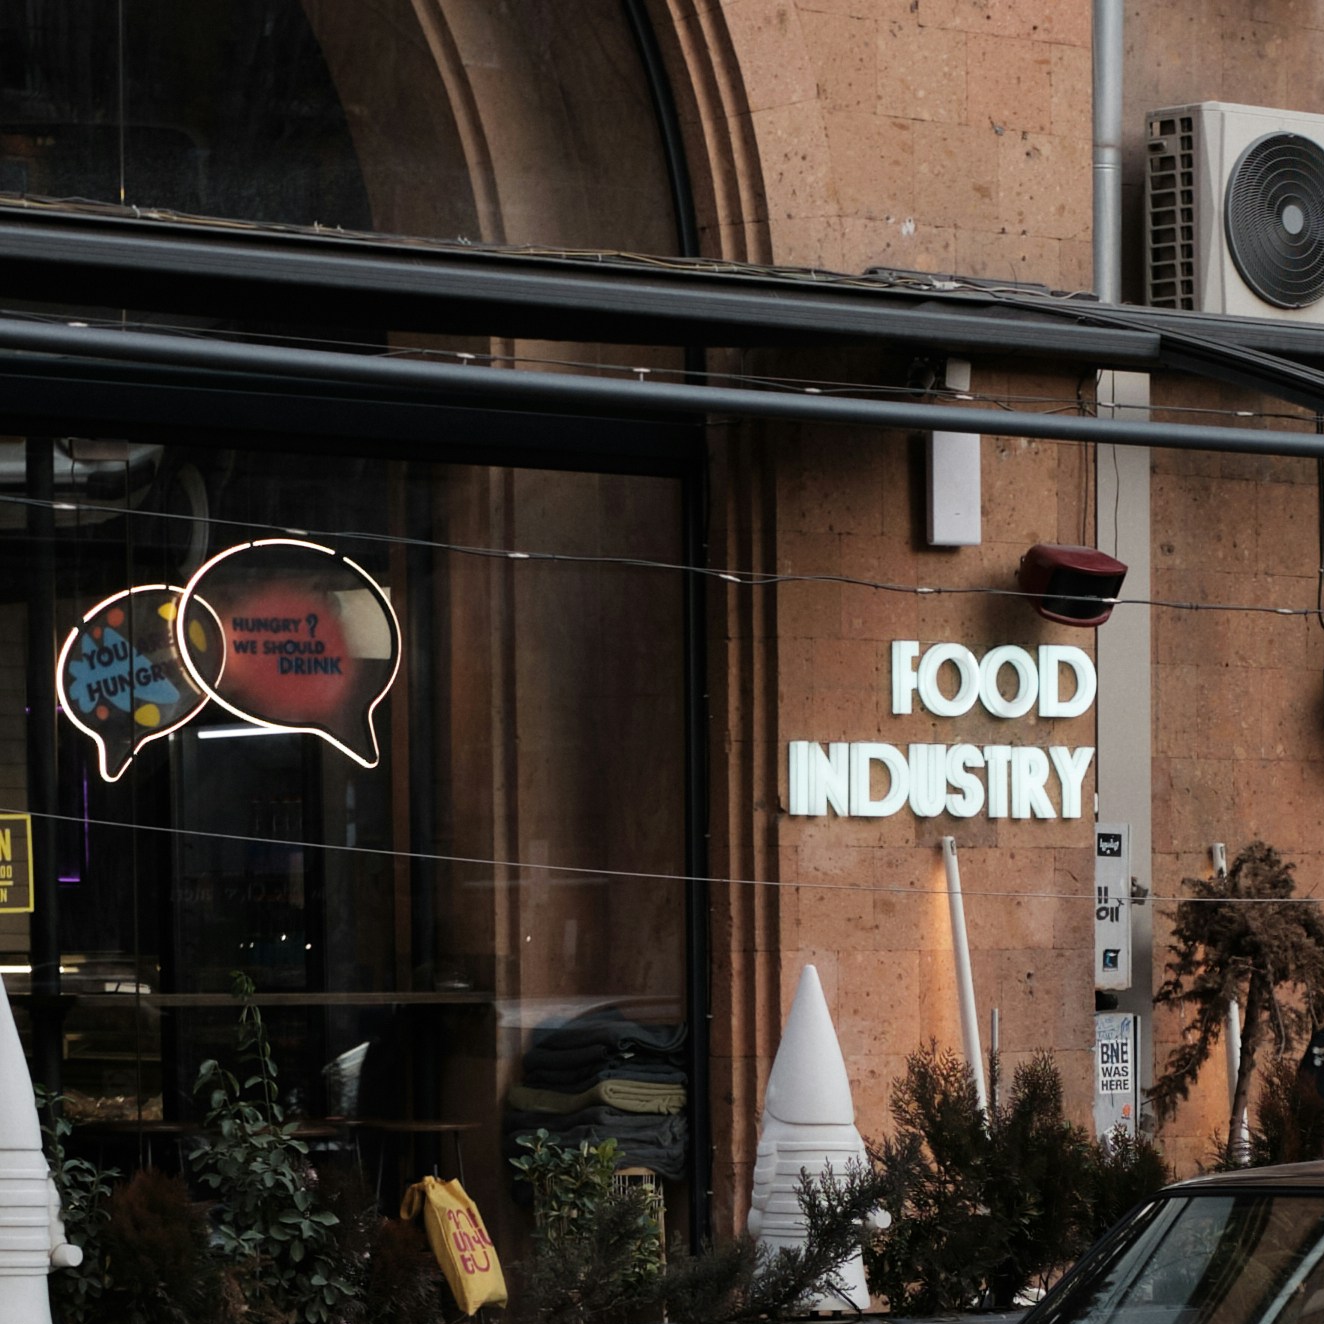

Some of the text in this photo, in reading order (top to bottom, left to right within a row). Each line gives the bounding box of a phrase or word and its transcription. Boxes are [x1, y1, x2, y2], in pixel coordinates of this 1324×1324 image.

[232, 617, 301, 633] HUNGRY
[83, 642, 128, 671] YOU
[233, 640, 325, 654] WE SHOULD
[277, 656, 342, 675] DRINK
[892, 640, 1098, 718] FOOD
[789, 740, 1095, 819] INDUSTRY
[1100, 1041, 1129, 1064] BNE
[1101, 1066, 1129, 1077] WAS
[1101, 1079, 1129, 1091] HERE
